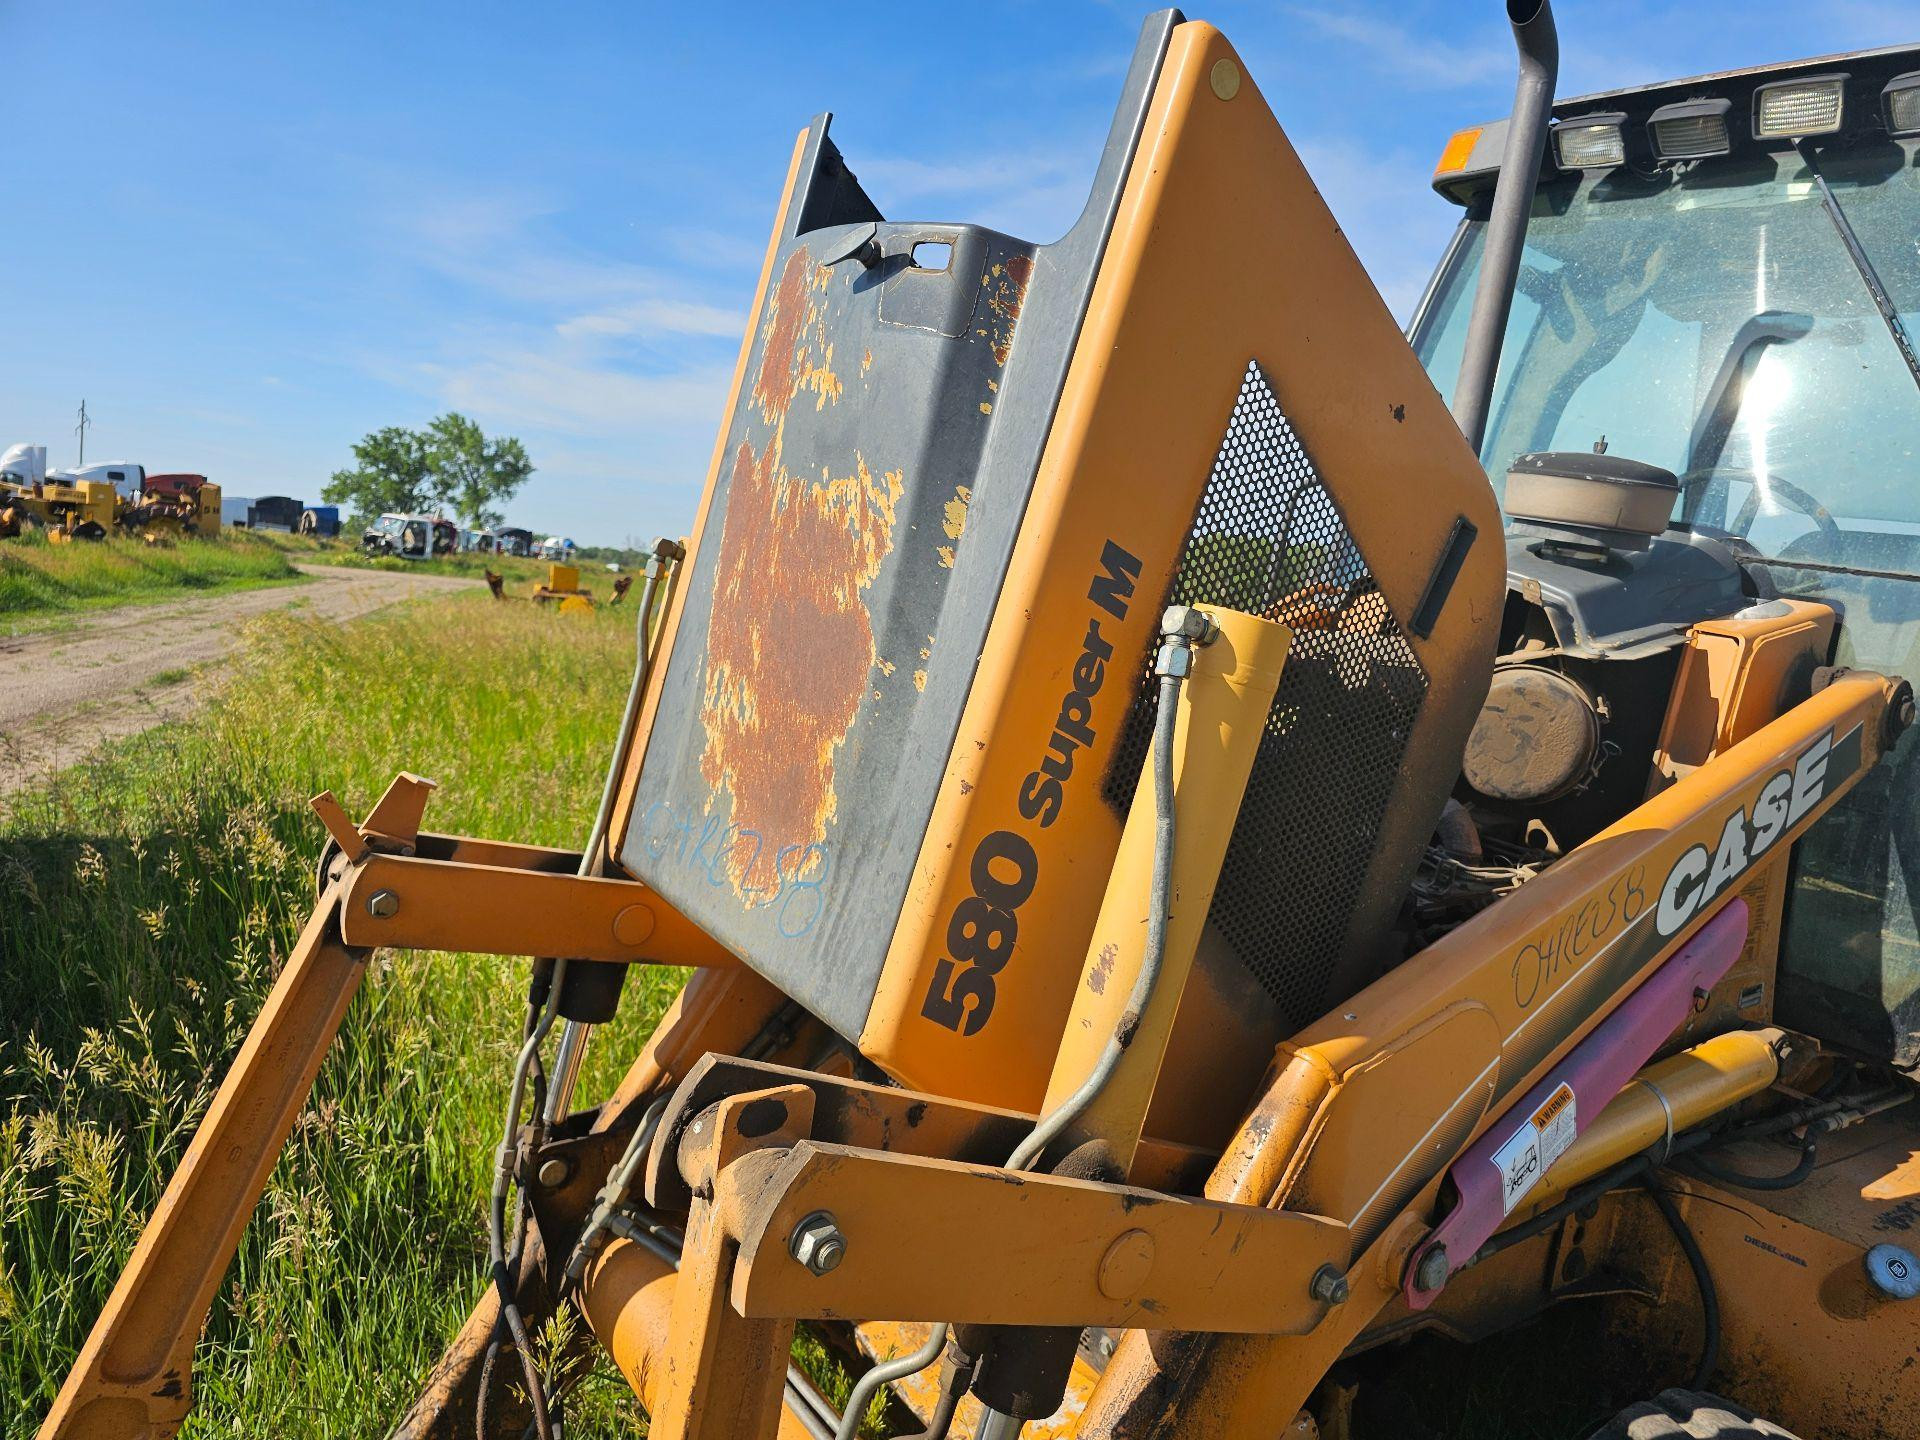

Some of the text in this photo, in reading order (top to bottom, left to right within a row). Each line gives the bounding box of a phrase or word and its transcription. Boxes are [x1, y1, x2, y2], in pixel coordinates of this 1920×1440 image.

[921, 539, 1143, 1036] 580 Super M
[1657, 728, 1833, 936] CASE
[1543, 1090, 1570, 1120] WARNING
